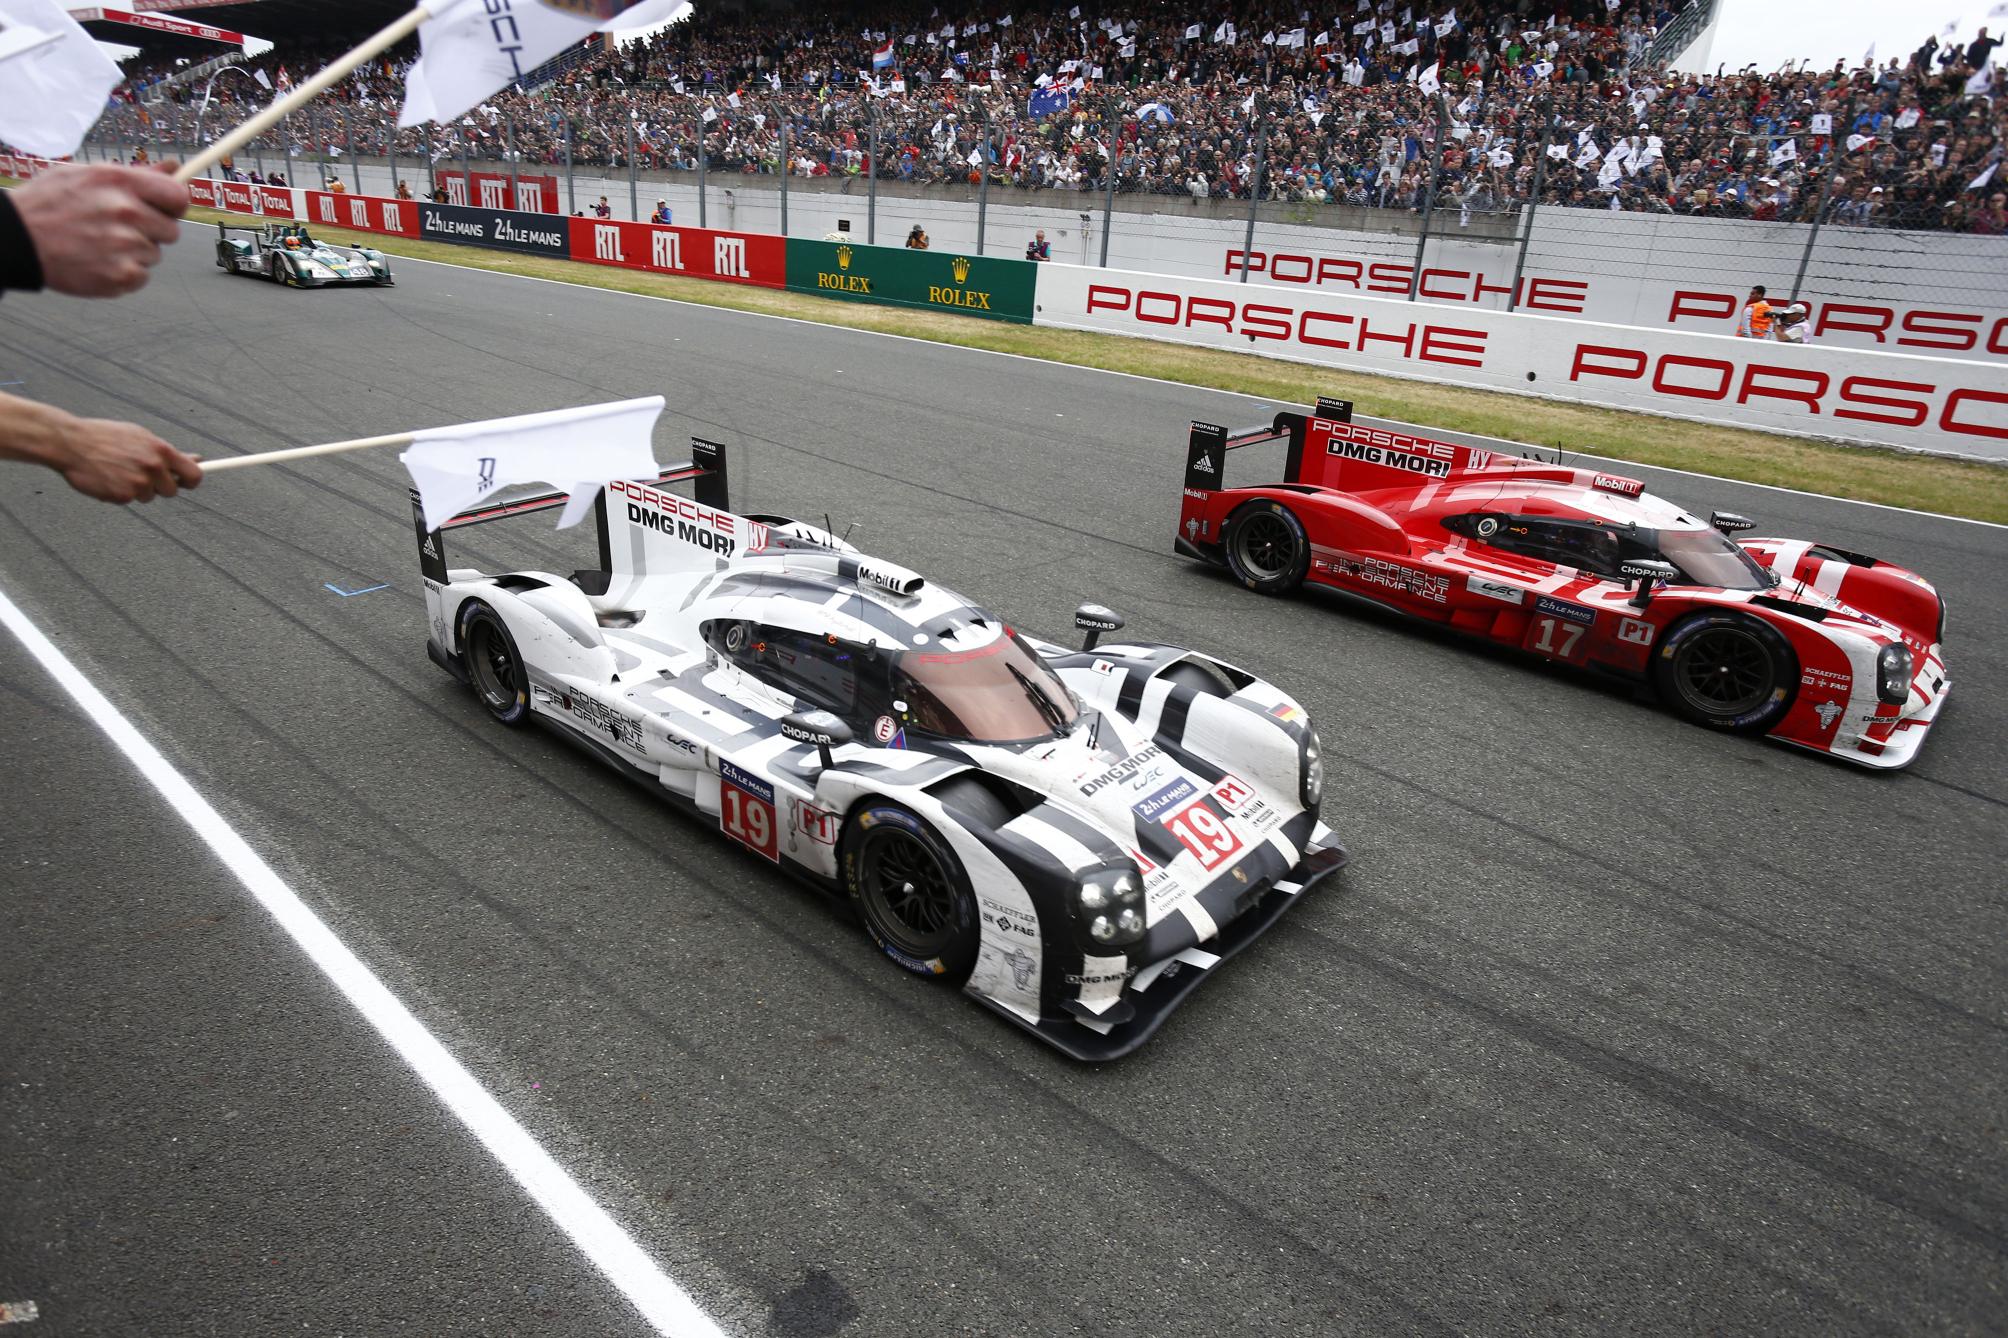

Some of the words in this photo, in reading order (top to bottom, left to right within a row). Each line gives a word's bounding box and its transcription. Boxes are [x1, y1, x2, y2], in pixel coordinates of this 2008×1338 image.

[224, 188, 251, 205] TOTAL
[262, 192, 291, 211] TOTAL
[319, 196, 338, 223] RTL
[350, 199, 370, 227] RTL
[382, 202, 403, 232] RTL
[443, 220, 455, 233] LE
[456, 222, 483, 237] MANS
[515, 228, 528, 243] LE
[529, 230, 561, 246] MANS
[594, 224, 624, 262] RTL
[652, 230, 684, 270] RTL
[714, 236, 749, 278] RTL
[818, 272, 870, 293] ROLEX
[1225, 249, 1588, 314] PORSCHE
[929, 286, 991, 310] ROLEX
[1087, 284, 1488, 368] PORSCHE
[1313, 420, 1455, 459] PORSCHE
[1193, 463, 1214, 474] adidas
[1328, 439, 1382, 463] DMG
[1385, 450, 1450, 477] MORI
[1468, 450, 1493, 470] HY
[610, 481, 734, 534] PORSCHE
[627, 502, 675, 536] DMG
[678, 521, 735, 559] MORI
[1715, 520, 1752, 529] CHOPARD
[1365, 557, 1449, 588] PORSCHE
[1621, 565, 1674, 580] CHOPARD
[1076, 617, 1116, 630] CHOPARD
[1535, 619, 1585, 658] 17
[1623, 621, 1649, 642] P1
[570, 685, 643, 734] PORSCHE
[1080, 767, 1124, 797] DMG
[1216, 782, 1246, 804] P1
[727, 789, 770, 848] 19
[803, 807, 826, 838] P1
[1171, 806, 1234, 868] 19
